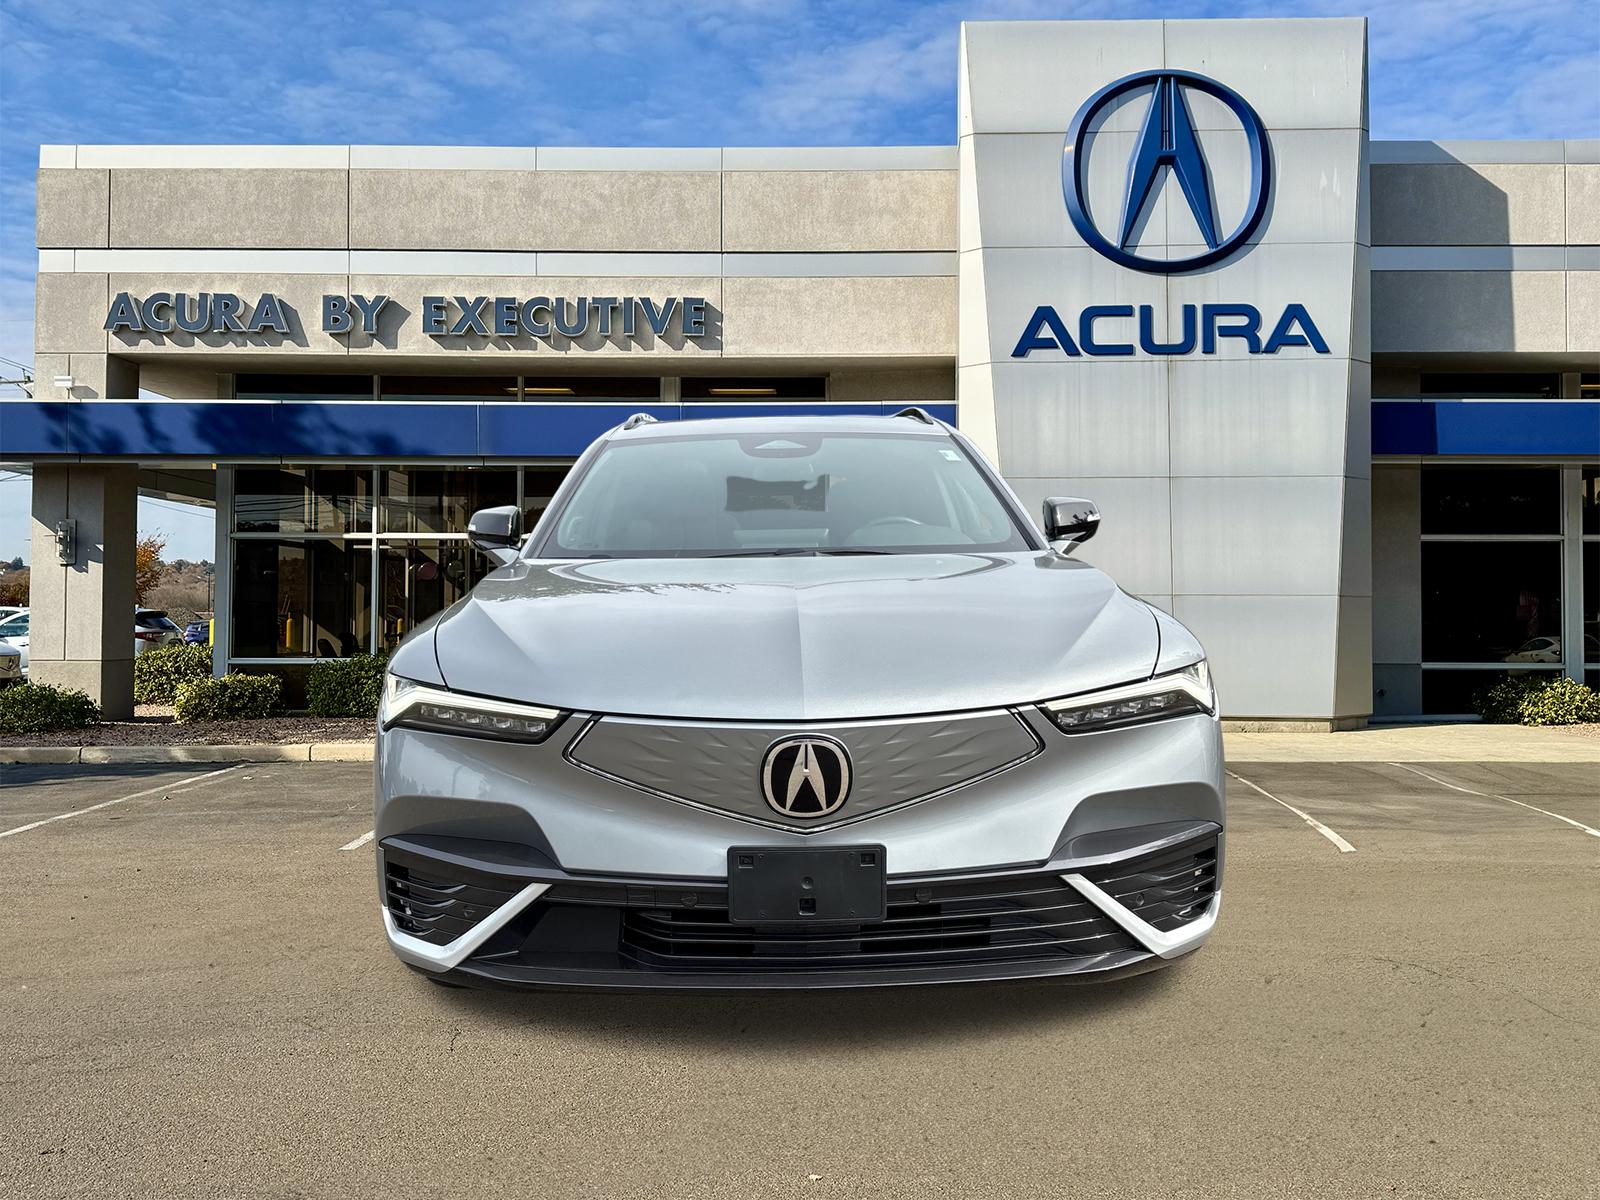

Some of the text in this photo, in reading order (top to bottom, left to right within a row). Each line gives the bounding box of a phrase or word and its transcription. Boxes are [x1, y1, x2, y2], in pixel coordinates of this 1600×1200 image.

[103, 292, 706, 337] ACURA BY EXECUTIVE
[1011, 303, 1331, 357] ACURA
